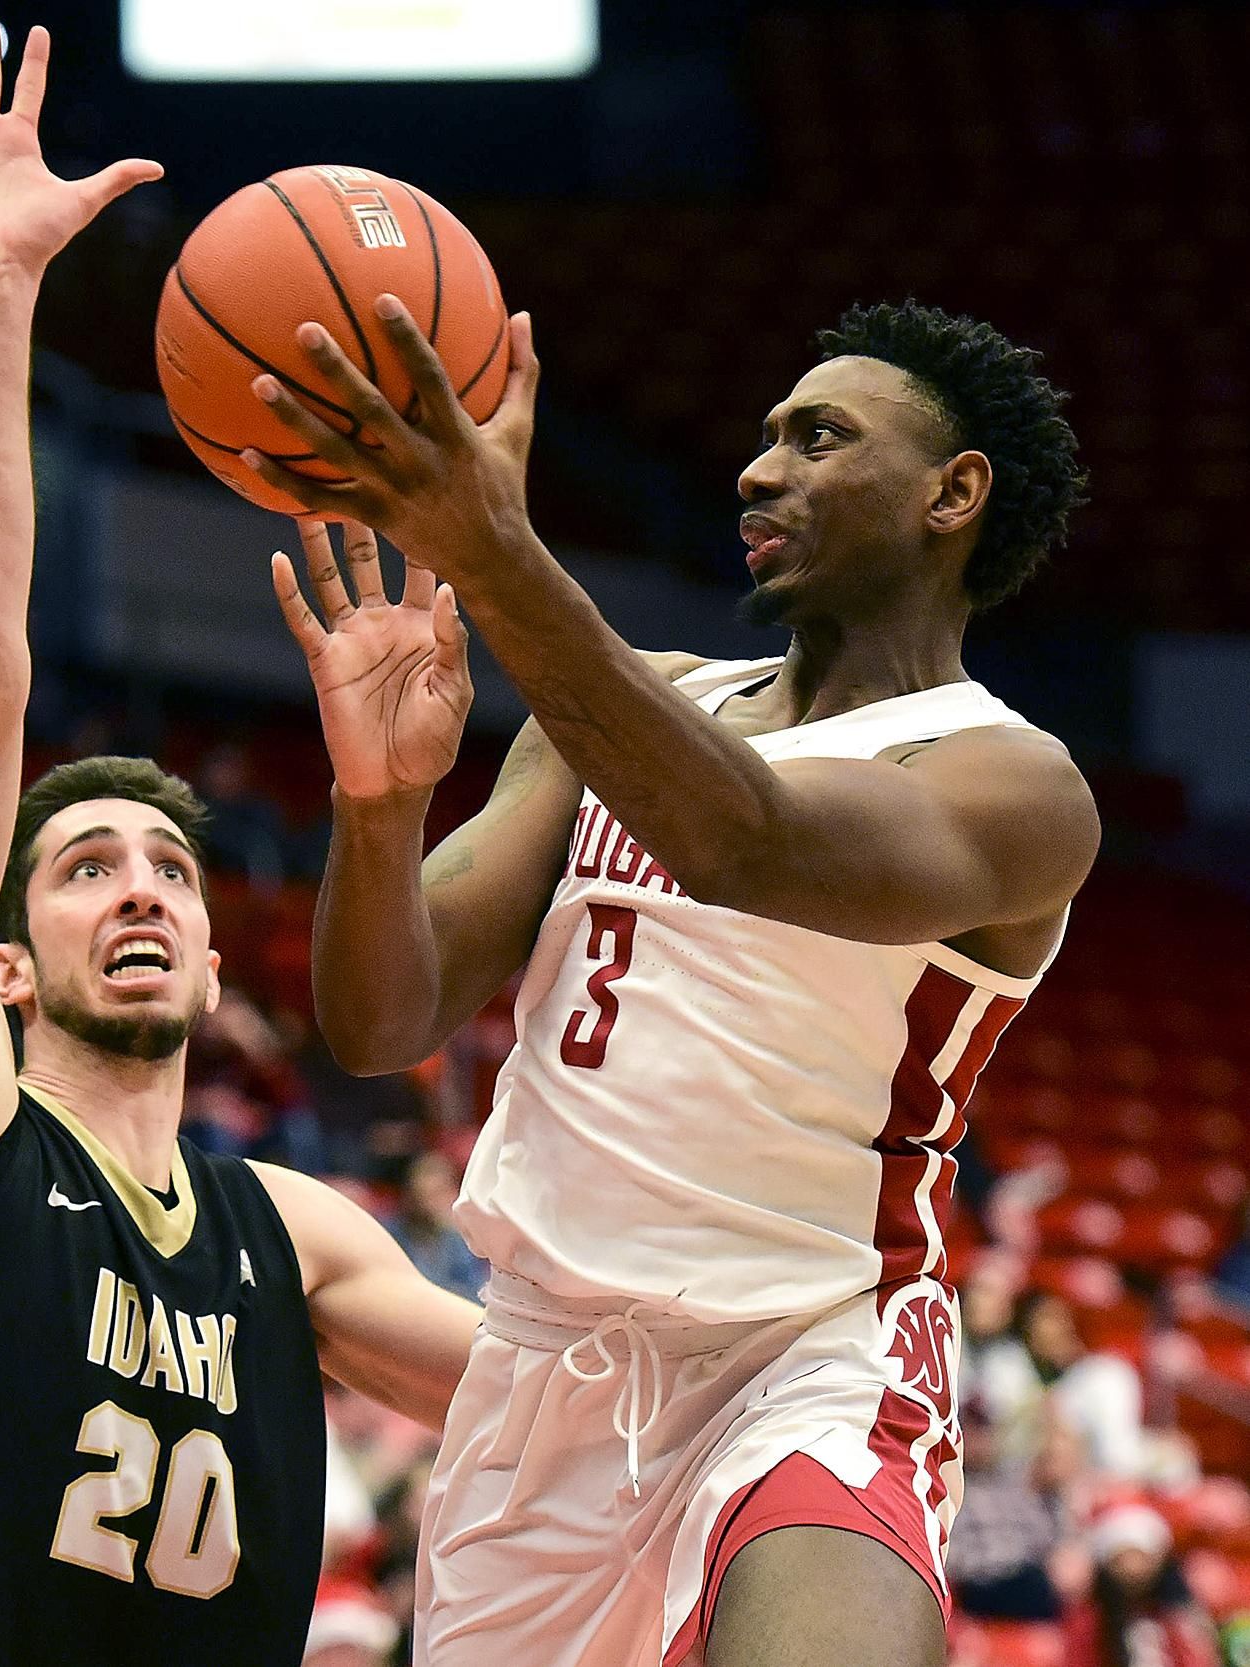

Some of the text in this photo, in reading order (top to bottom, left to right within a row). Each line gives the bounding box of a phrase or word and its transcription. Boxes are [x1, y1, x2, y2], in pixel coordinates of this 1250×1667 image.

[560, 902, 637, 1069] 3
[87, 1267, 238, 1415] IDAHO
[50, 1400, 241, 1600] 20
